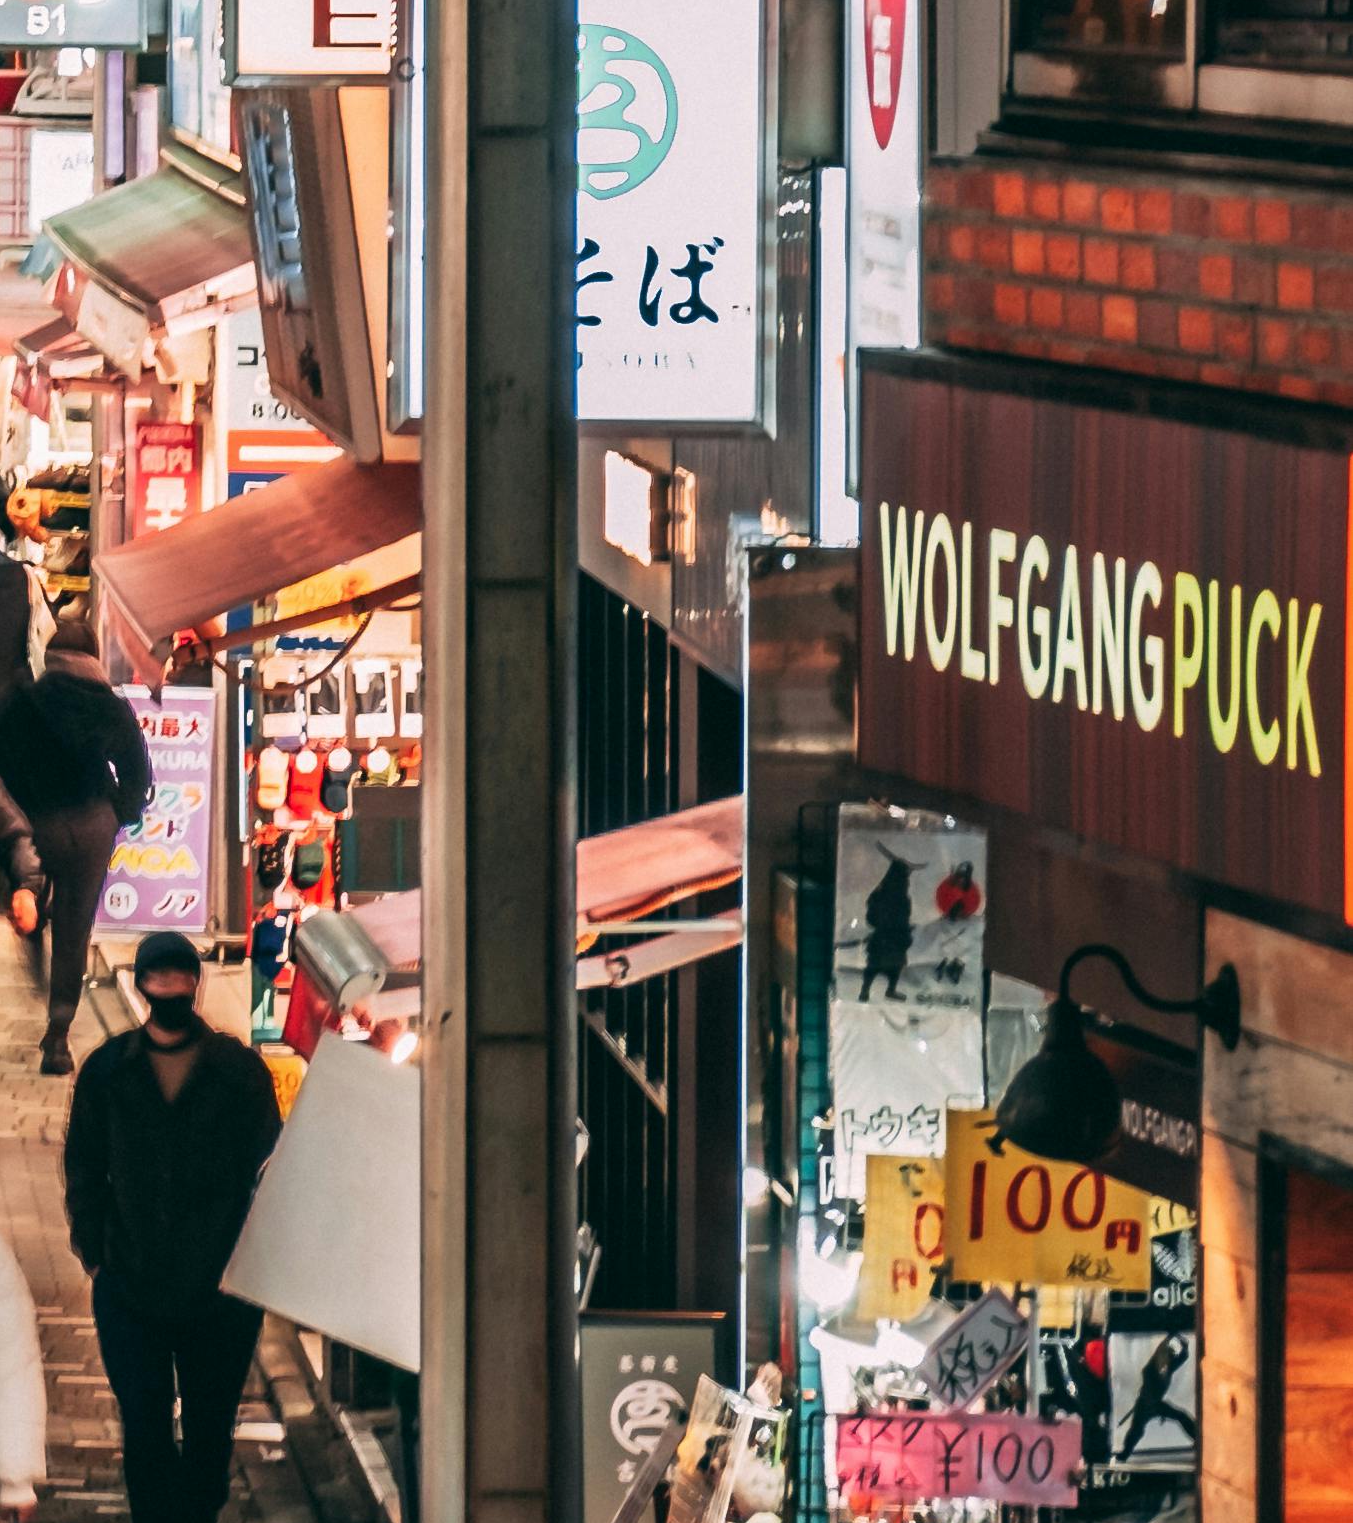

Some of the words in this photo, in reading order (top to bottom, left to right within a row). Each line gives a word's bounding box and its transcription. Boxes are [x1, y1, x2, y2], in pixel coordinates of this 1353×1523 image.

[880, 500, 1165, 733] WOLFGANG
[1174, 570, 1323, 778] PUCK
[934, 1430, 1056, 1494] ¥100
